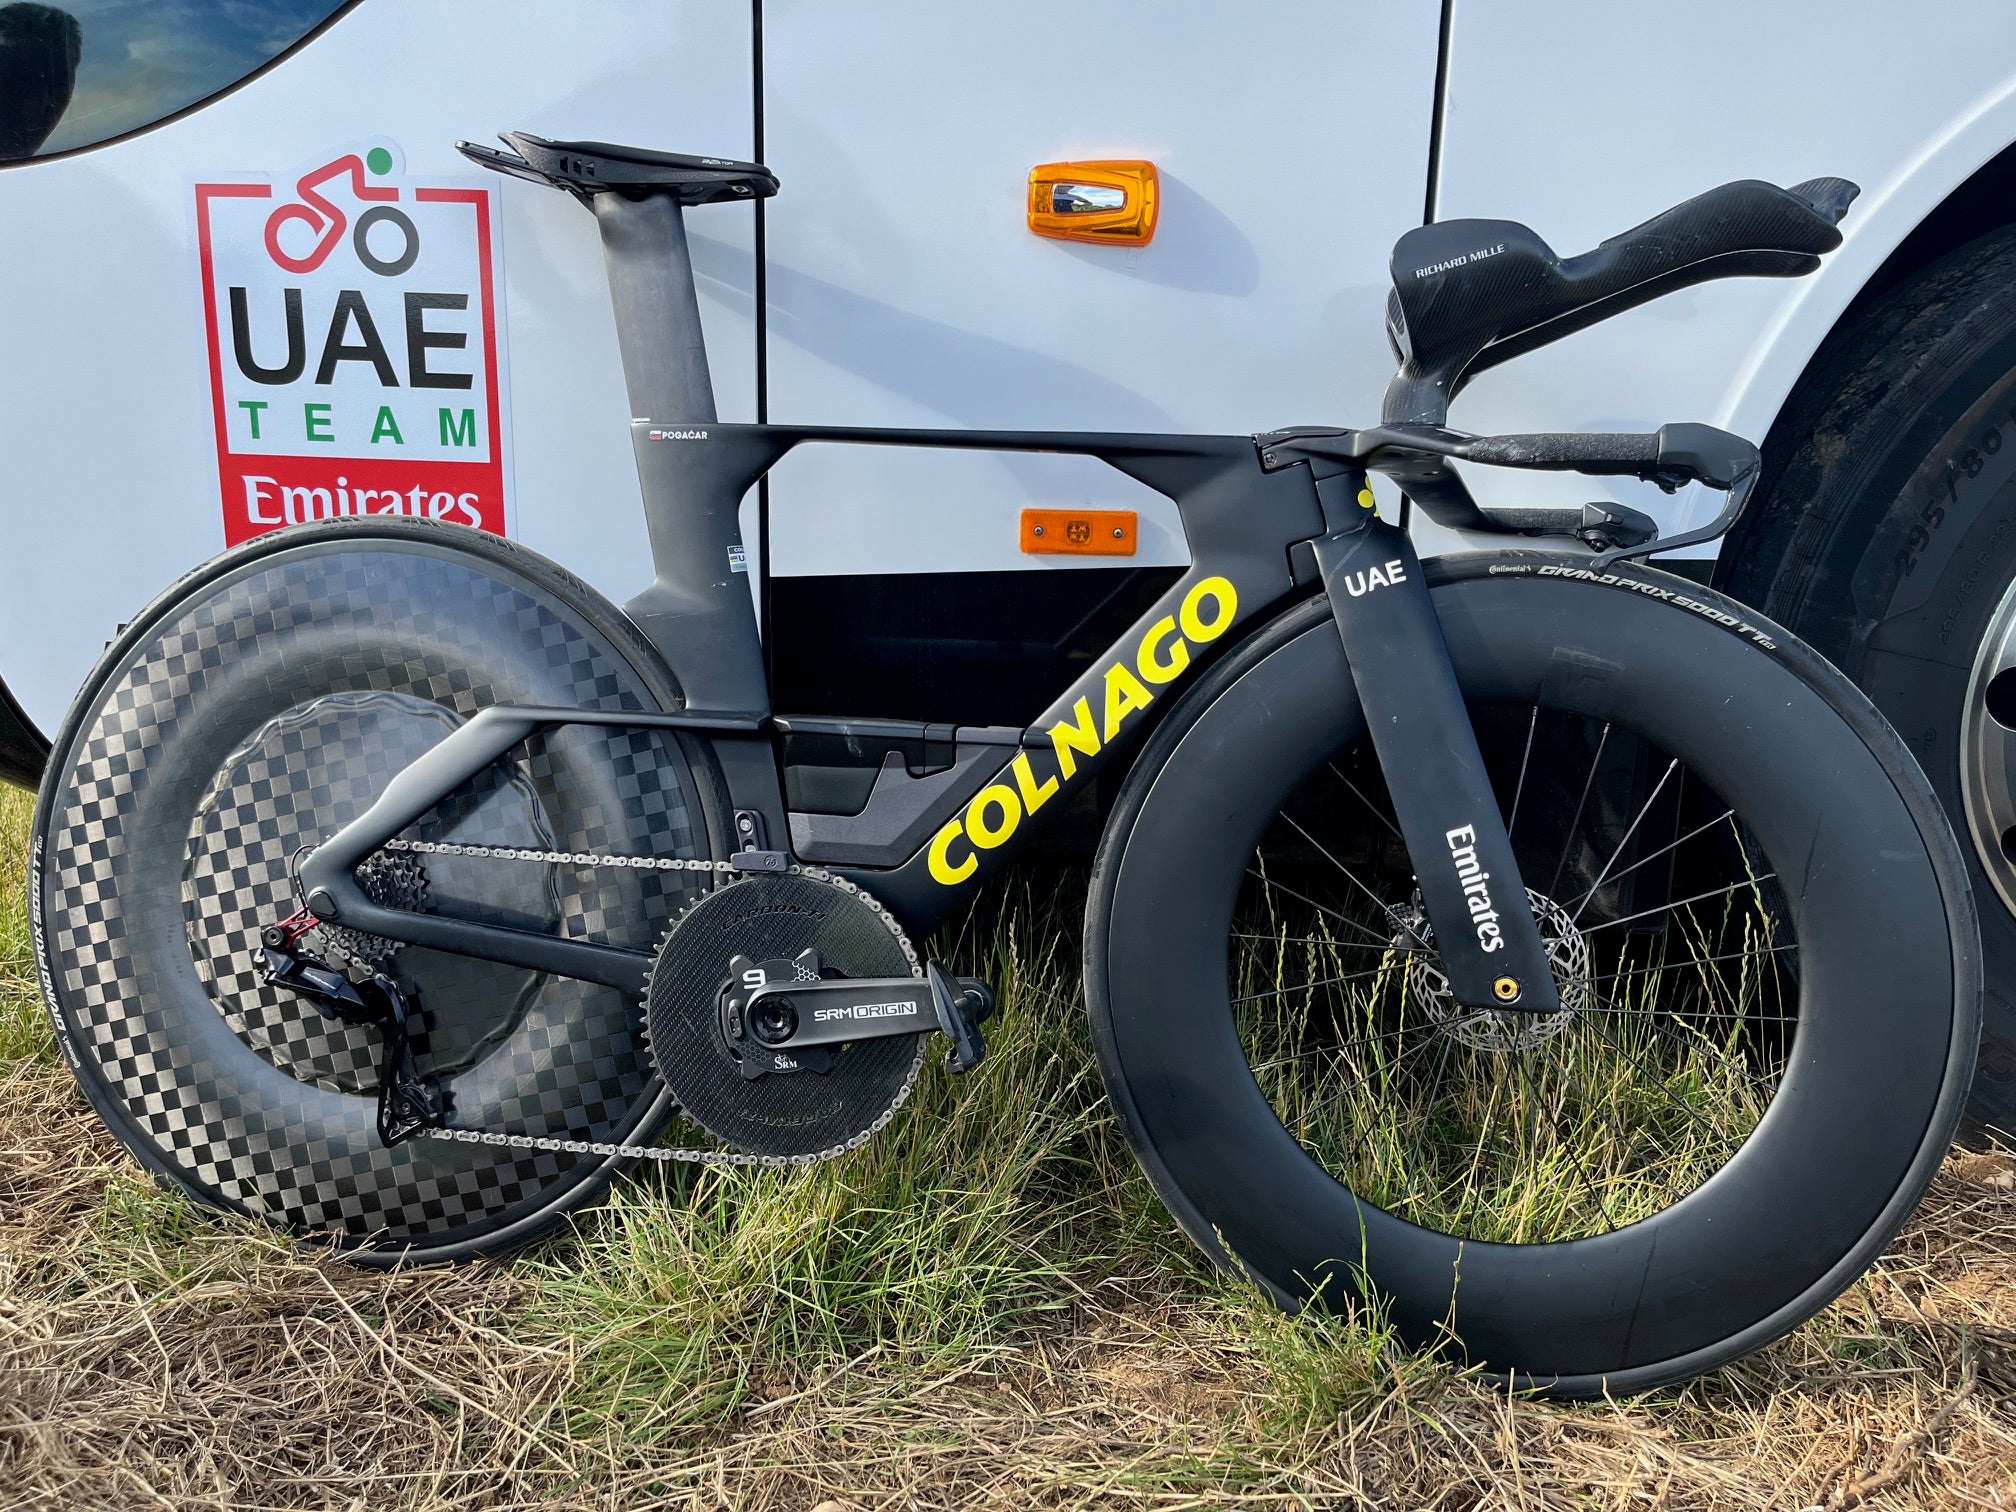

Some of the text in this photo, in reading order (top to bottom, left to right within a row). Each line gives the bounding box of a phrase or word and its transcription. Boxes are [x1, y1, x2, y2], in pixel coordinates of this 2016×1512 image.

[1415, 243, 1506, 279] RICHARD MILLE
[229, 286, 473, 390] UAE
[238, 400, 477, 447] TEAM
[1344, 559, 1407, 597] UAE
[1488, 564, 1526, 575] Continental
[1537, 564, 1616, 585] GRAND
[1615, 578, 1676, 601] PRIX
[1671, 595, 1741, 627] 5000
[927, 576, 1238, 886] COLNAGO
[32, 872, 42, 924] 5000
[1446, 823, 1504, 953] Emirates
[723, 904, 827, 932] CARBON-TI
[33, 924, 48, 973] PRIX
[814, 1002, 914, 1022] SRM ORIGIN
[774, 1056, 797, 1070] SRM
